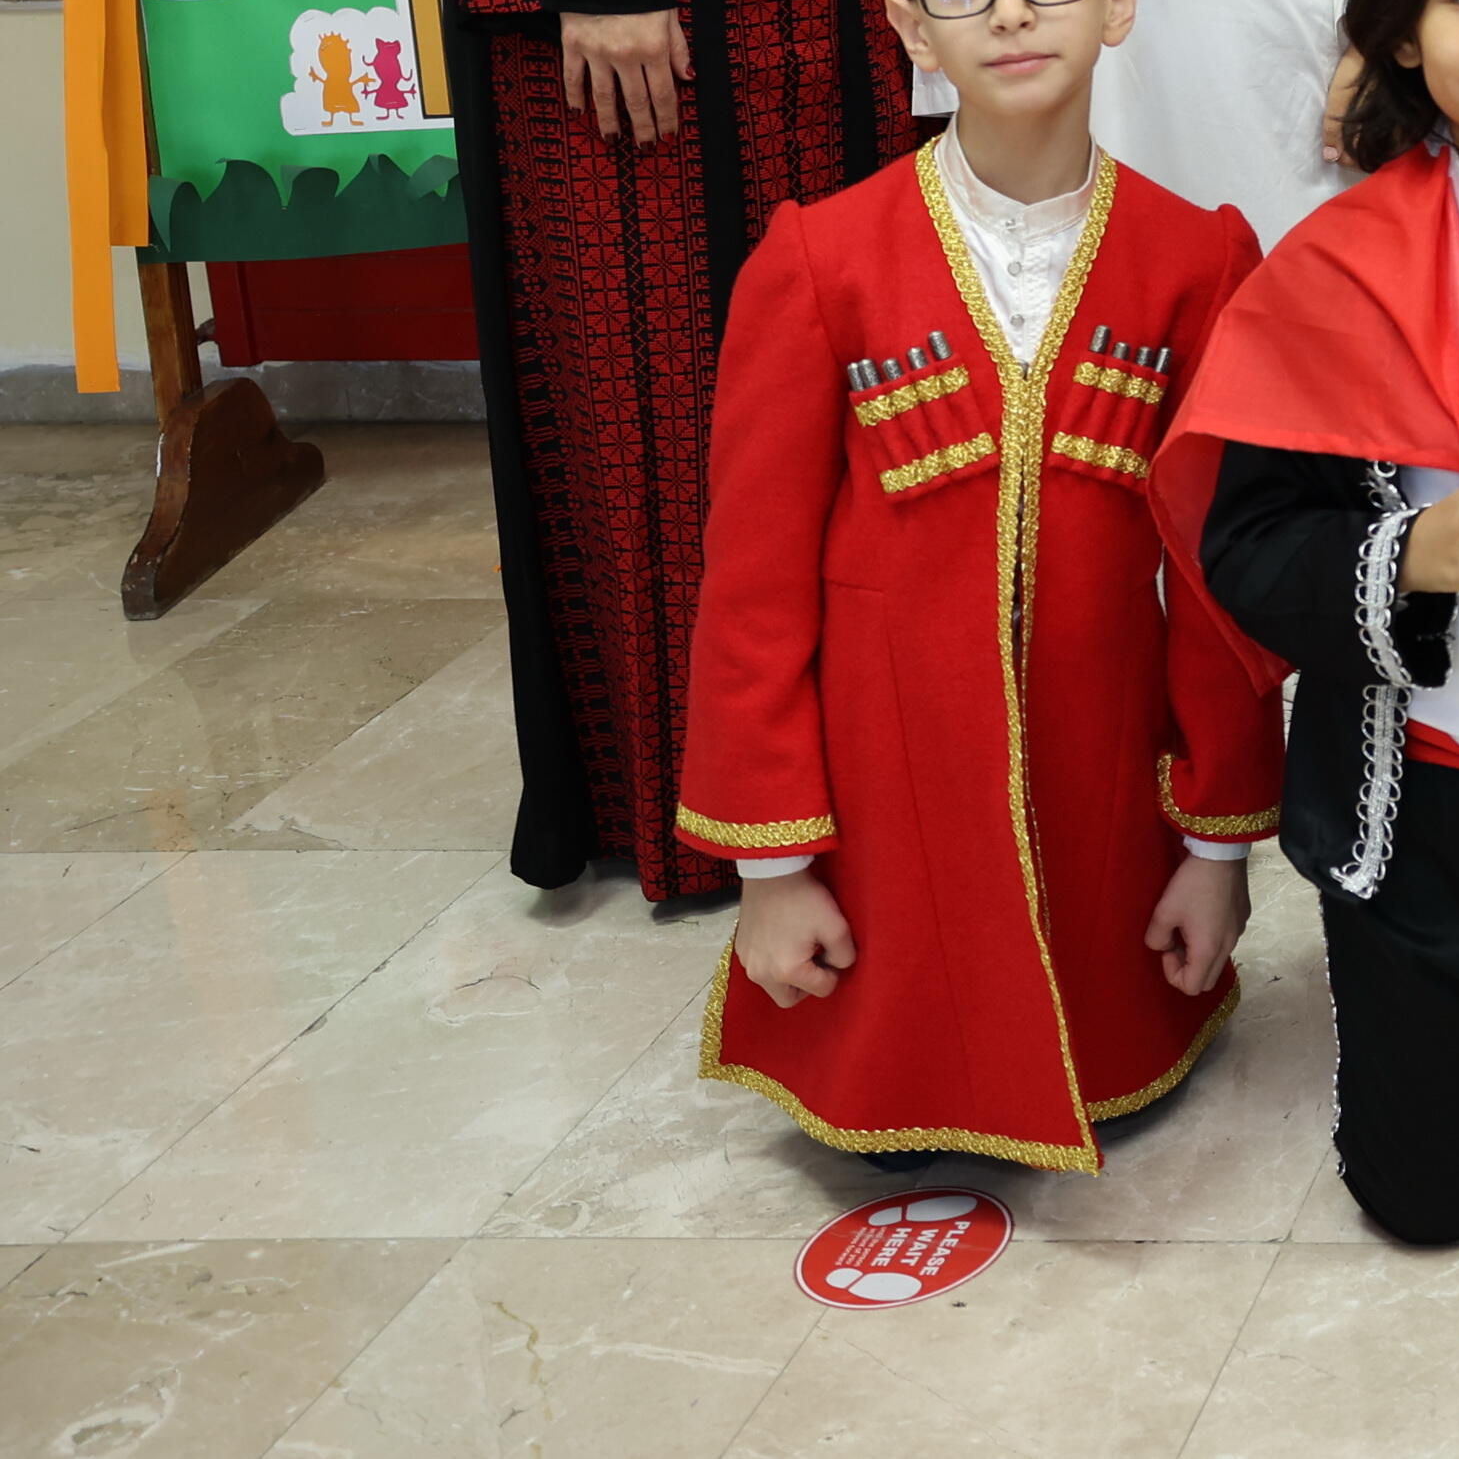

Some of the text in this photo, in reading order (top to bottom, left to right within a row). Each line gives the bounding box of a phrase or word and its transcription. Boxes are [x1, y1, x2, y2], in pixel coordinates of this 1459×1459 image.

[870, 1227, 912, 1267] HERE
[900, 1229, 939, 1266] WAIT
[919, 1221, 971, 1276] PLEASE
